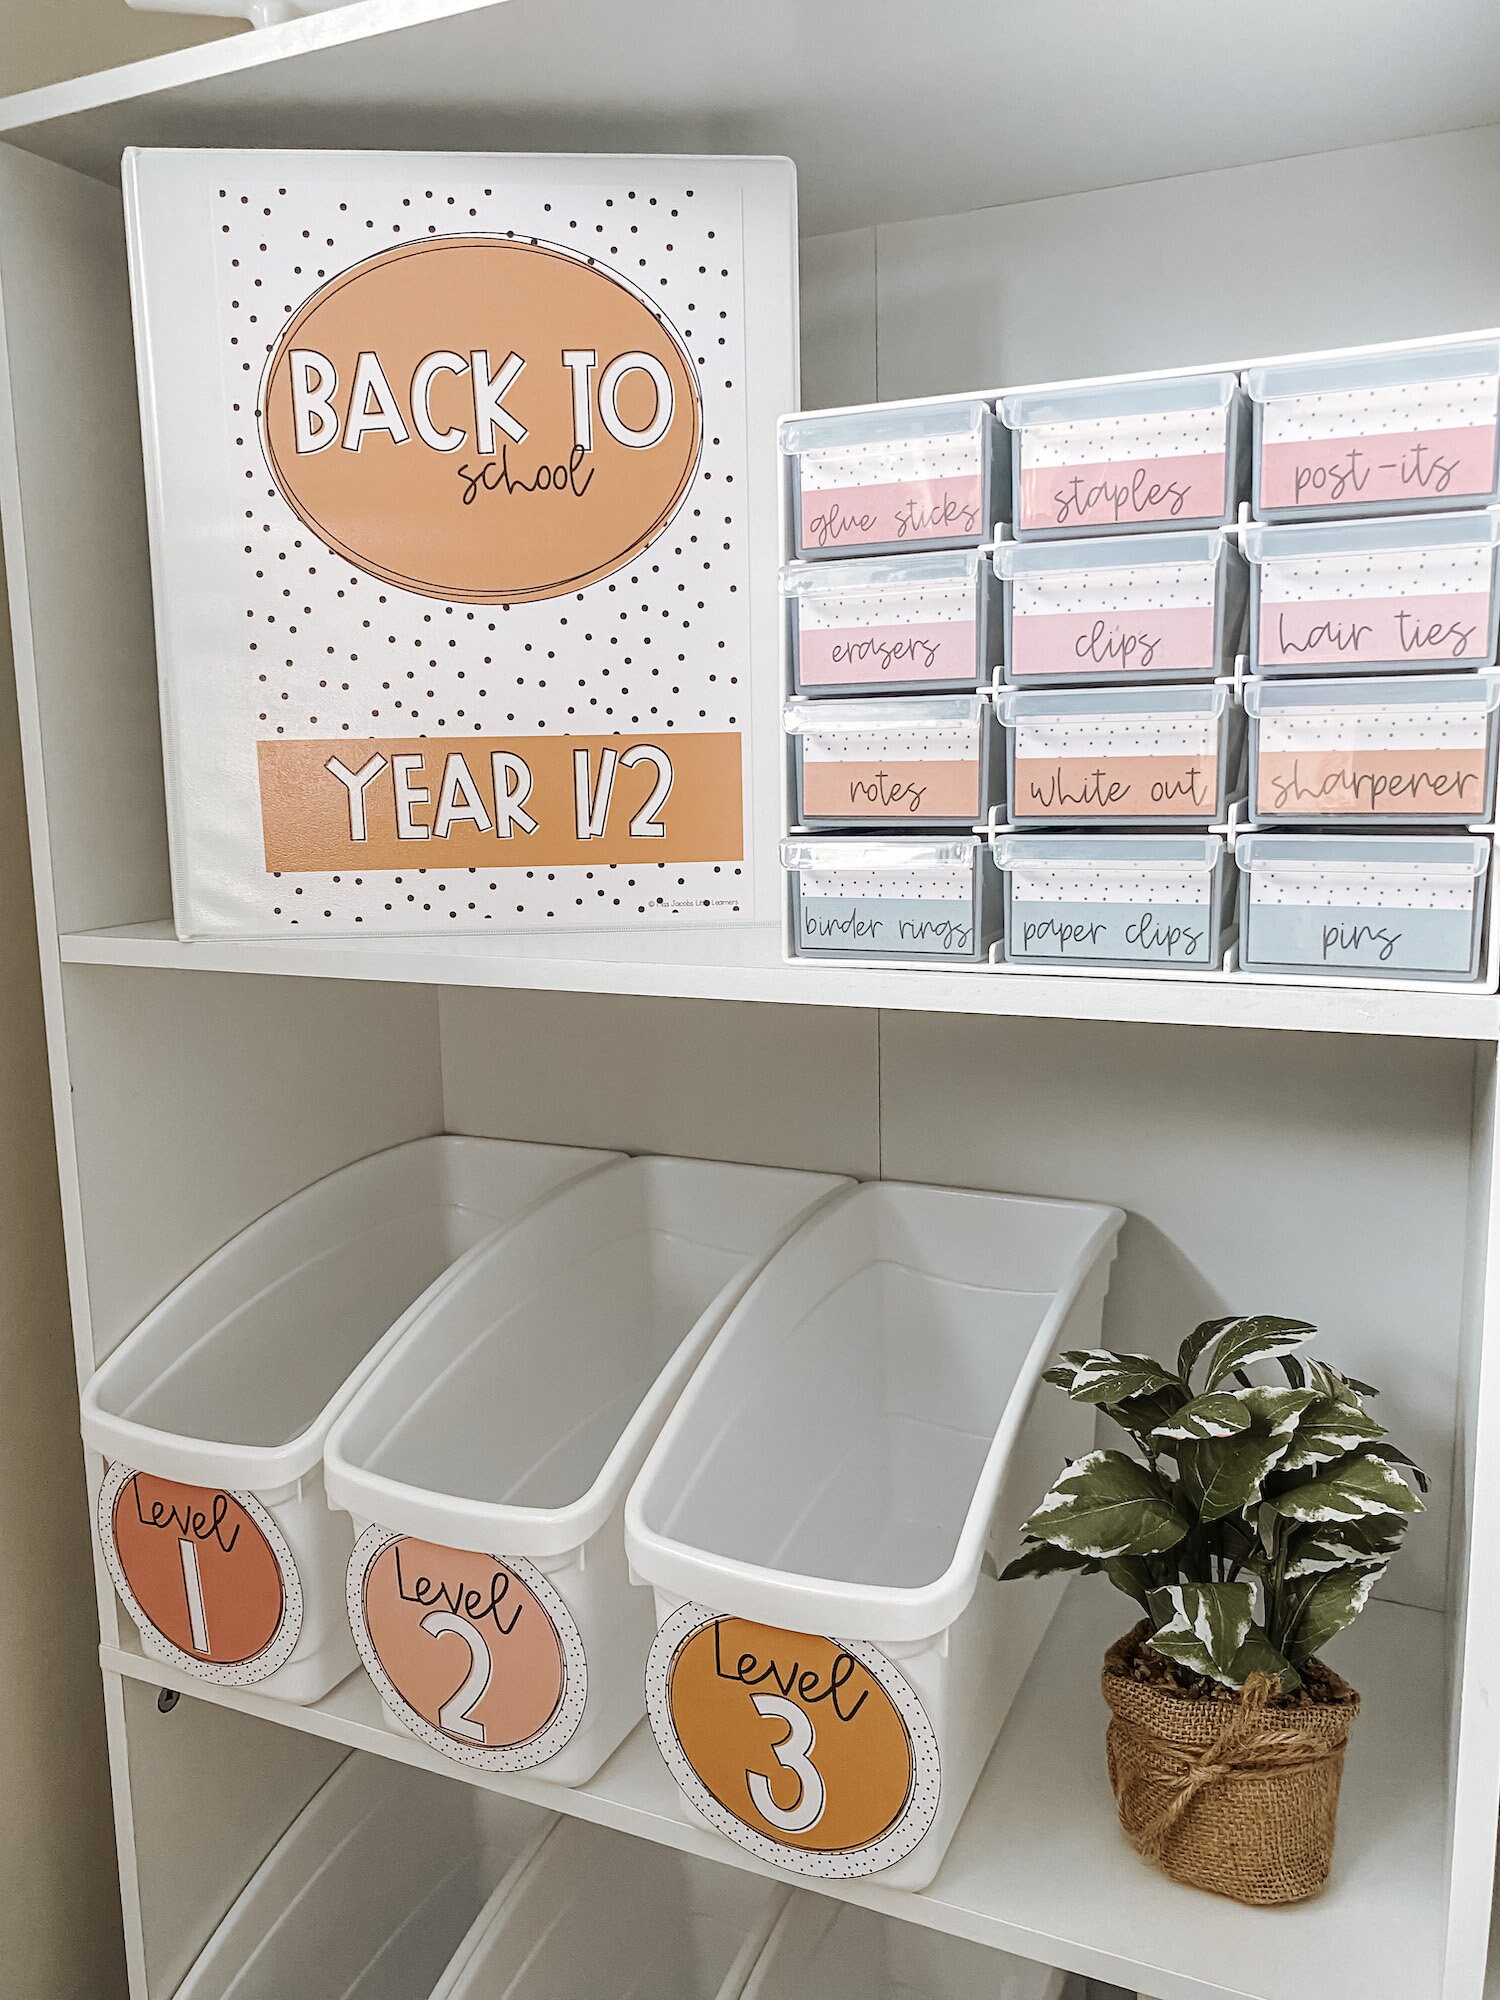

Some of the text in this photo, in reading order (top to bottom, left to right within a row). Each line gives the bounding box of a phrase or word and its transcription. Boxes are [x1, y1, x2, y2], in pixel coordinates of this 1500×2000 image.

[288, 349, 675, 455] BACK TO
[457, 444, 595, 506] school
[1053, 468, 1193, 524] staples
[1294, 443, 1461, 505] post-its
[810, 491, 980, 547] glue sticks
[831, 637, 941, 670] erasers
[1074, 619, 1162, 669] clips
[1279, 610, 1477, 657] hair ties
[323, 751, 541, 843] YEAR
[849, 770, 927, 812] notes
[1030, 766, 1208, 807] white out
[1271, 758, 1479, 811] sharpener
[711, 898, 739, 906] Learners
[805, 906, 973, 949] binder rings
[1023, 912, 1204, 957] paper clips
[1322, 922, 1403, 961] pins
[132, 1472, 241, 1553] Level
[178, 1537, 211, 1656] 1
[395, 1546, 523, 1635] Level
[419, 1610, 494, 1744] 2
[715, 1620, 869, 1722] Level
[745, 1692, 826, 1834] 3
